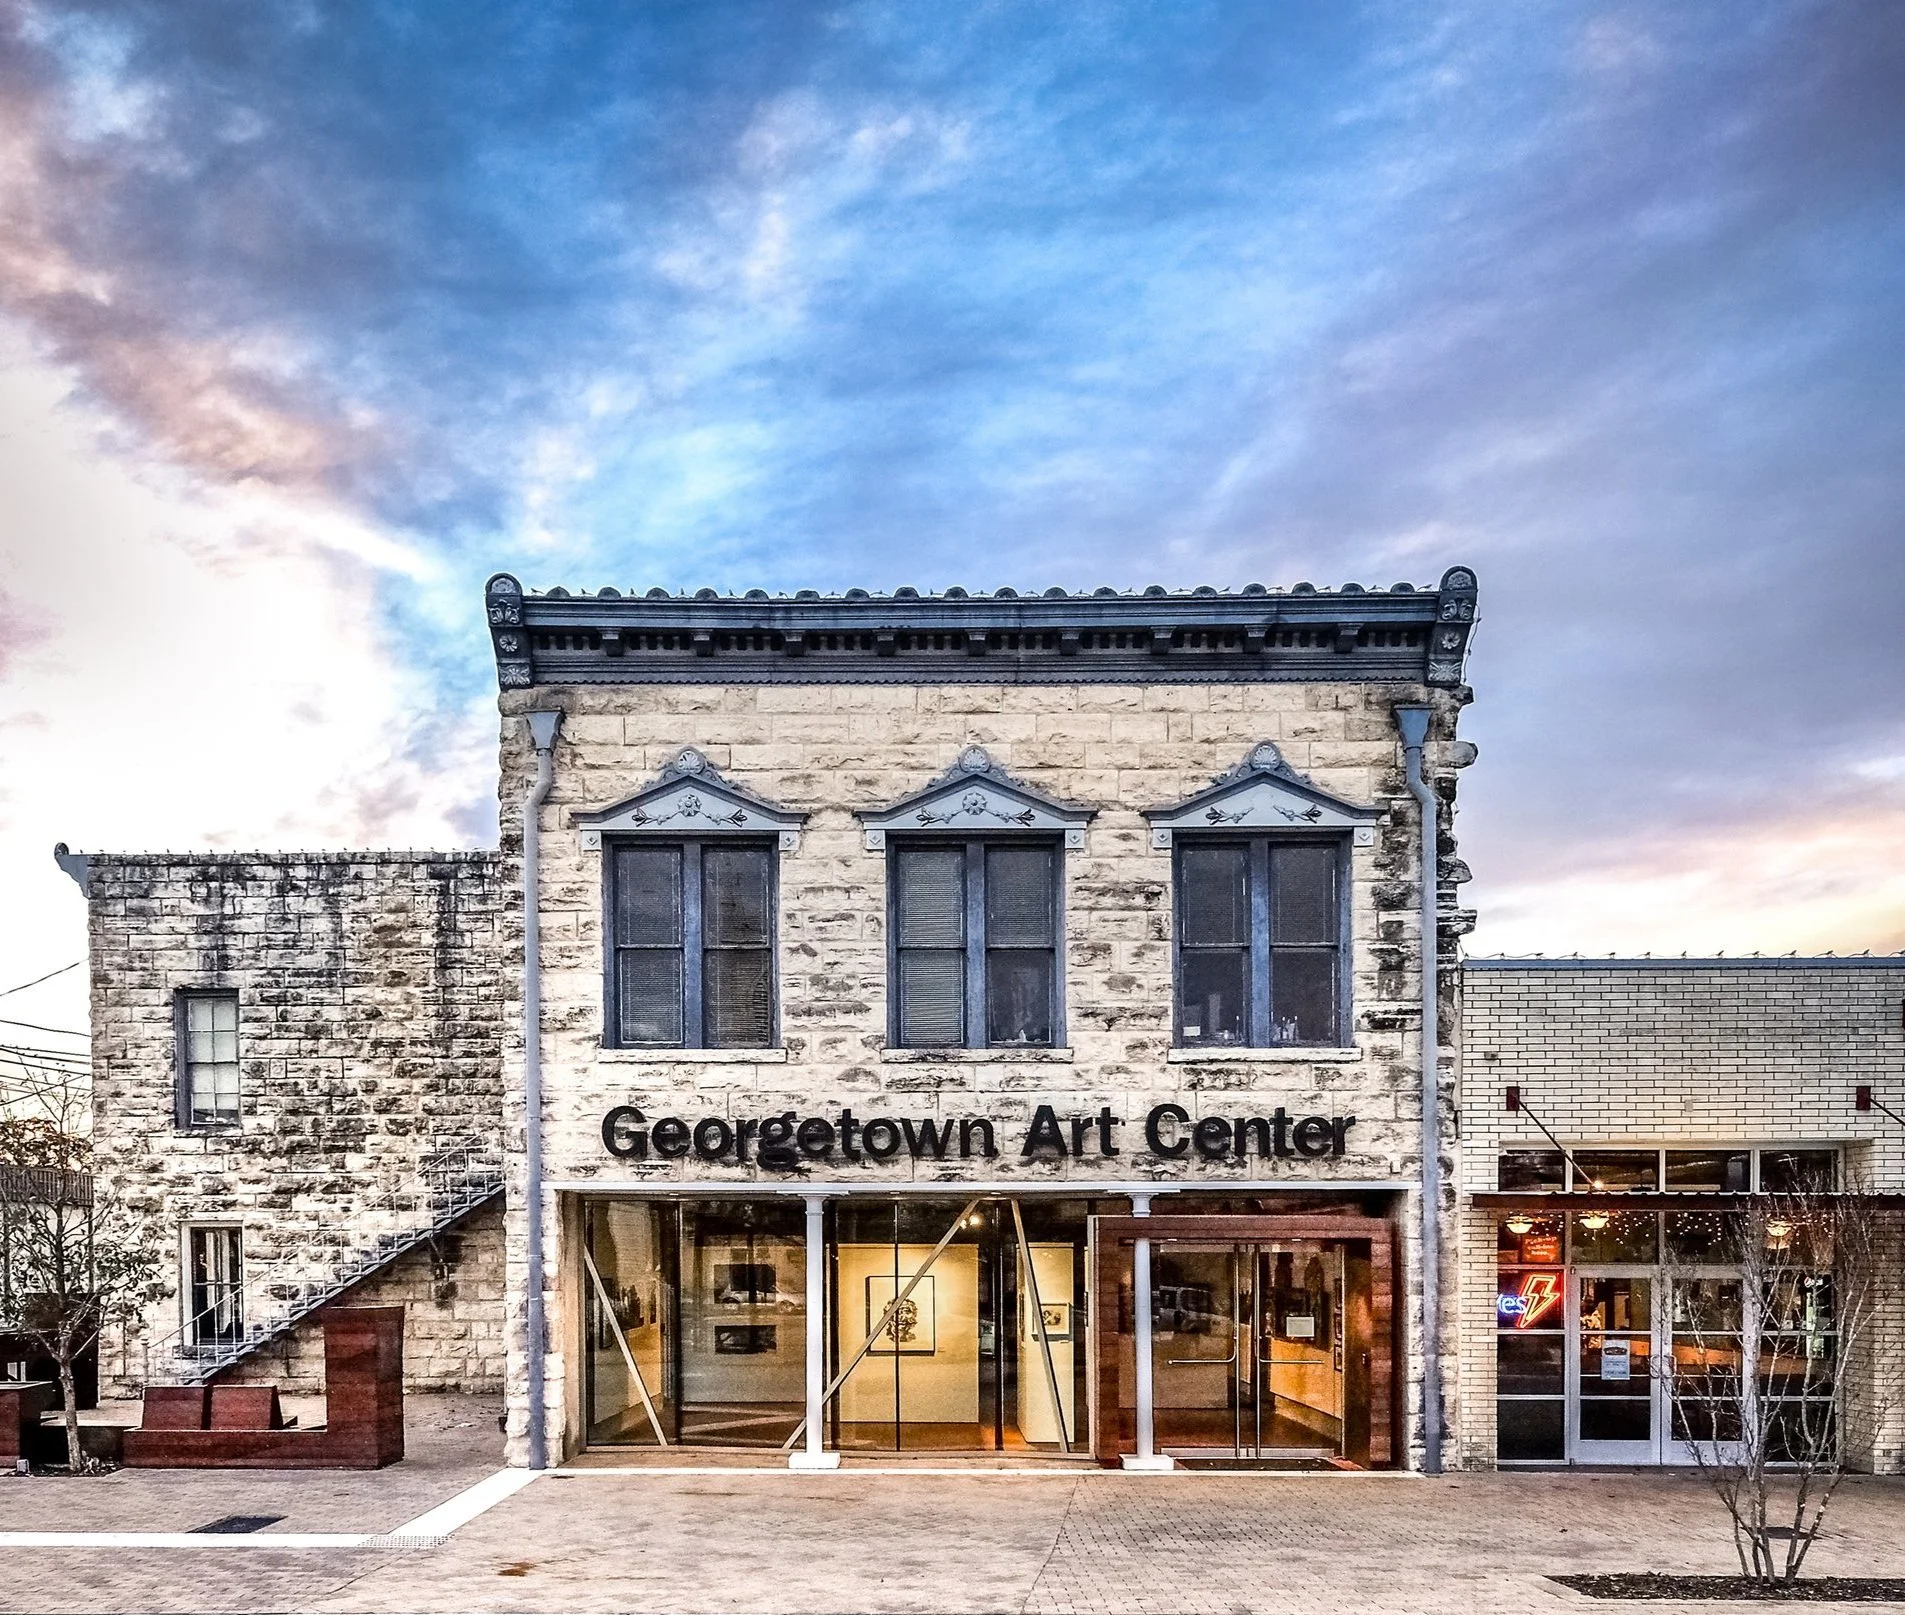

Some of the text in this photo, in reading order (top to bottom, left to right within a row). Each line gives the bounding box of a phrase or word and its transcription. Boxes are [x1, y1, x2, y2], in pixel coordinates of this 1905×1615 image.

[601, 1103, 1356, 1170] Georgetown Art Center
[1497, 1293, 1527, 1314] es
